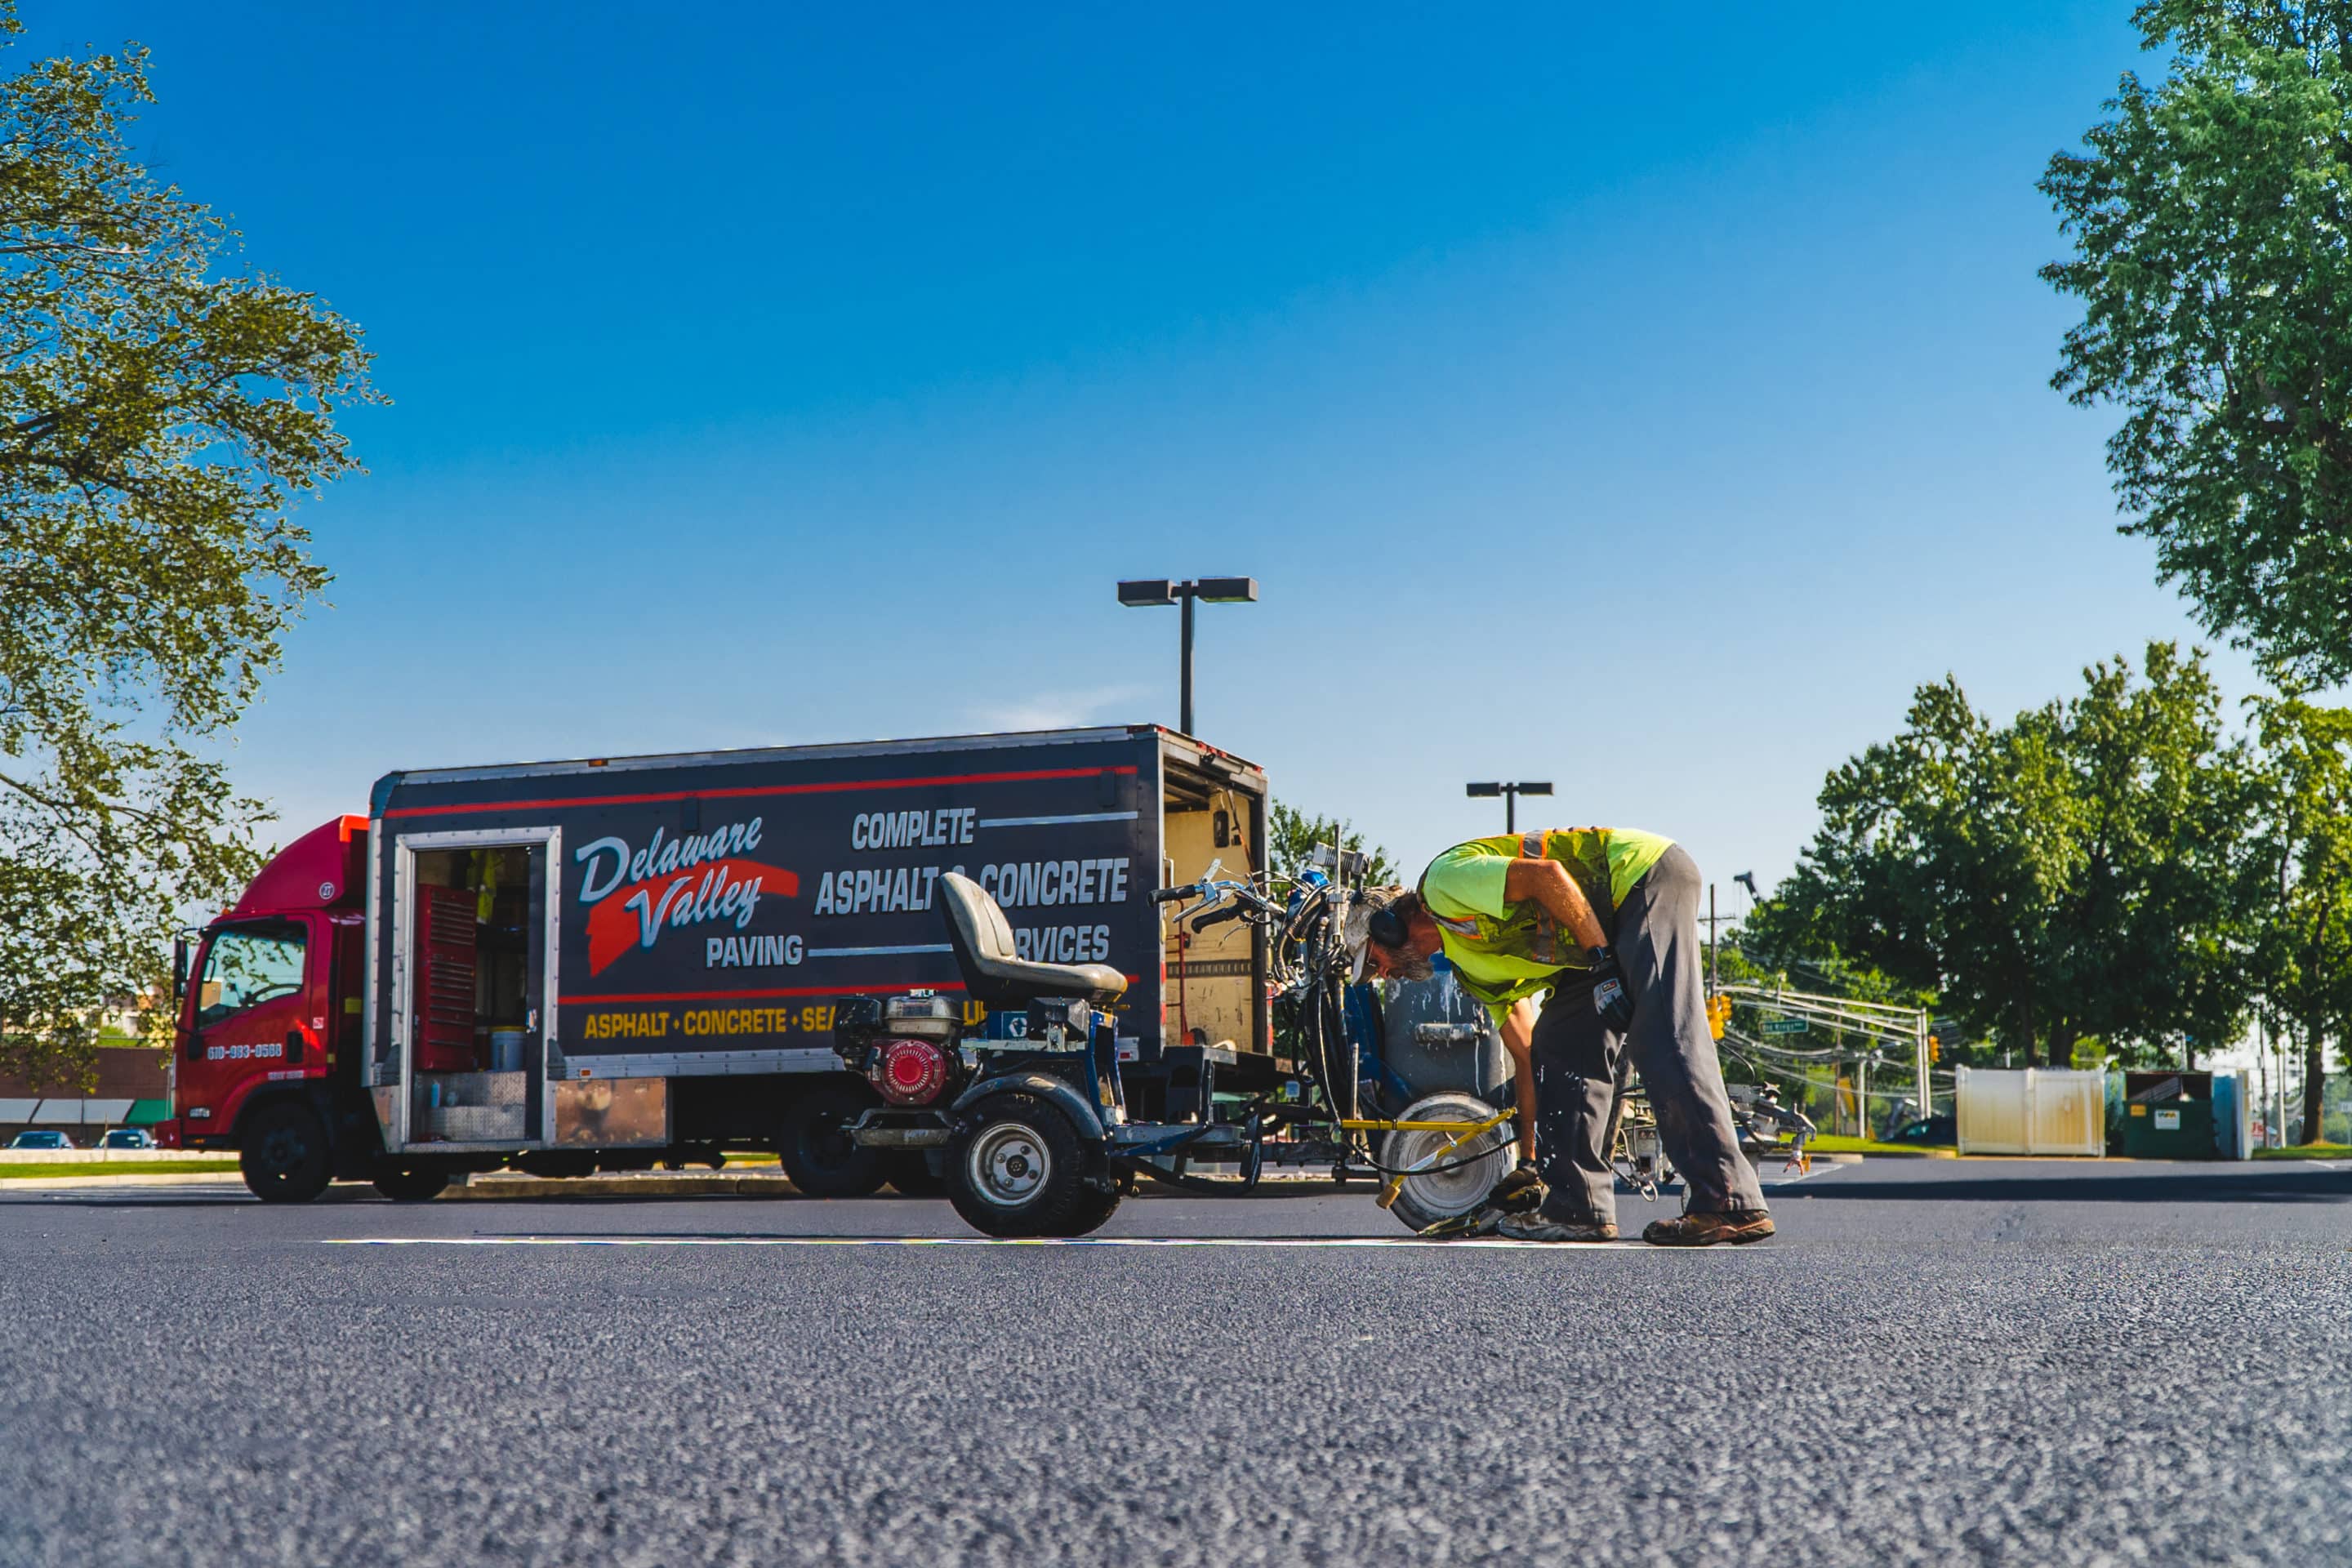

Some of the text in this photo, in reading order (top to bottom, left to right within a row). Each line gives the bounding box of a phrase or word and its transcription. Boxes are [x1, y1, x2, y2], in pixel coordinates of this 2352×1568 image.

[852, 807, 976, 850] COMPLETE
[576, 817, 763, 902] Delaware
[624, 865, 763, 948] Valley
[814, 858, 1129, 915] ASPHALT CONCRETE
[706, 934, 803, 968] PAVING
[1011, 924, 1110, 961] RVICES
[585, 1012, 670, 1039] ASPHALT
[684, 1008, 786, 1036] CONCRETE
